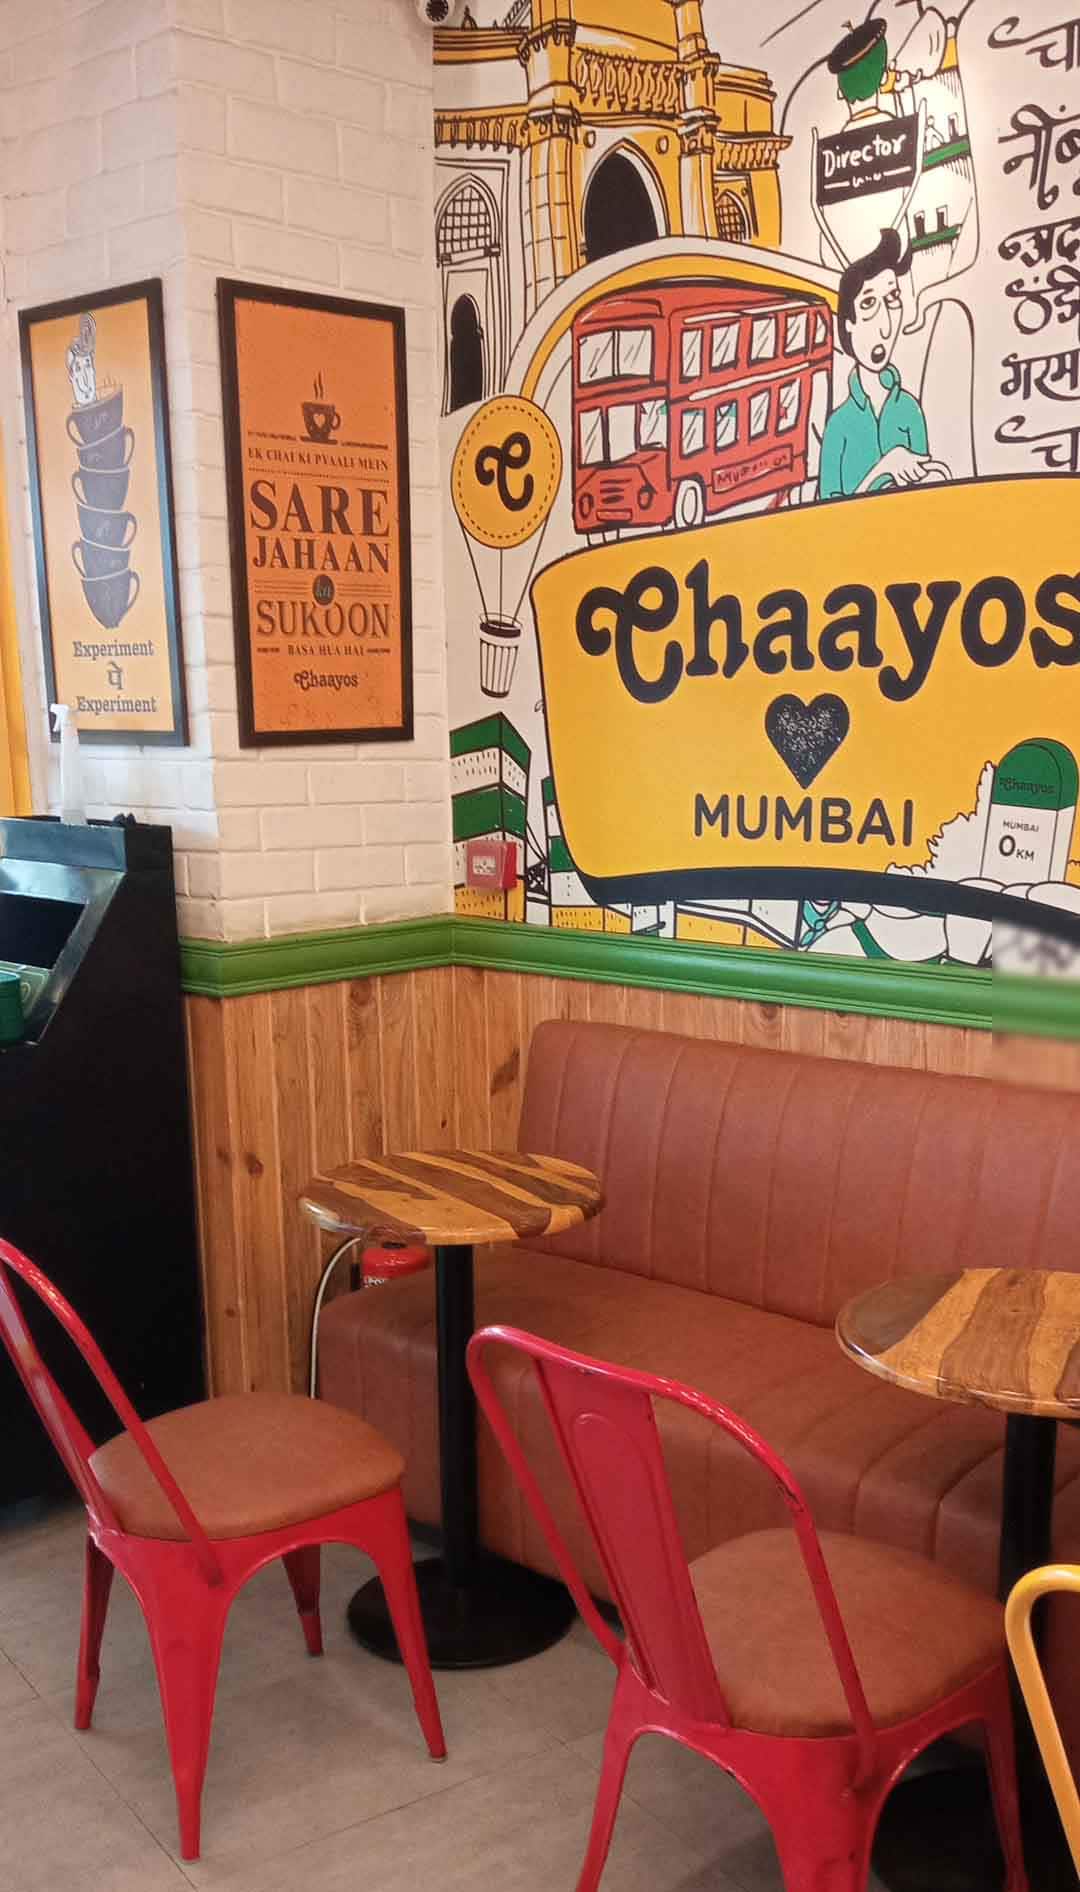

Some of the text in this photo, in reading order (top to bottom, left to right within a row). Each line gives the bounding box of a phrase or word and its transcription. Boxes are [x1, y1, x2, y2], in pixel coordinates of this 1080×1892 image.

[822, 134, 906, 178] Director
[266, 449, 294, 463] CHAI
[299, 453, 312, 465] KI
[314, 454, 353, 468] PYAALI
[357, 457, 389, 471] MEIN
[250, 479, 390, 537] SARE
[252, 535, 389, 573] JAHAAN
[256, 600, 390, 638] SUKOON
[576, 559, 1080, 702] Chaayos
[73, 640, 154, 661] Experiment
[288, 644, 364, 656] BASA HUA HAI
[106, 661, 123, 690] पे
[293, 669, 358, 691] Chaayos
[76, 695, 157, 716] Experiment
[694, 794, 913, 847] MUMBAI
[1002, 820, 1039, 832] MUMBAI
